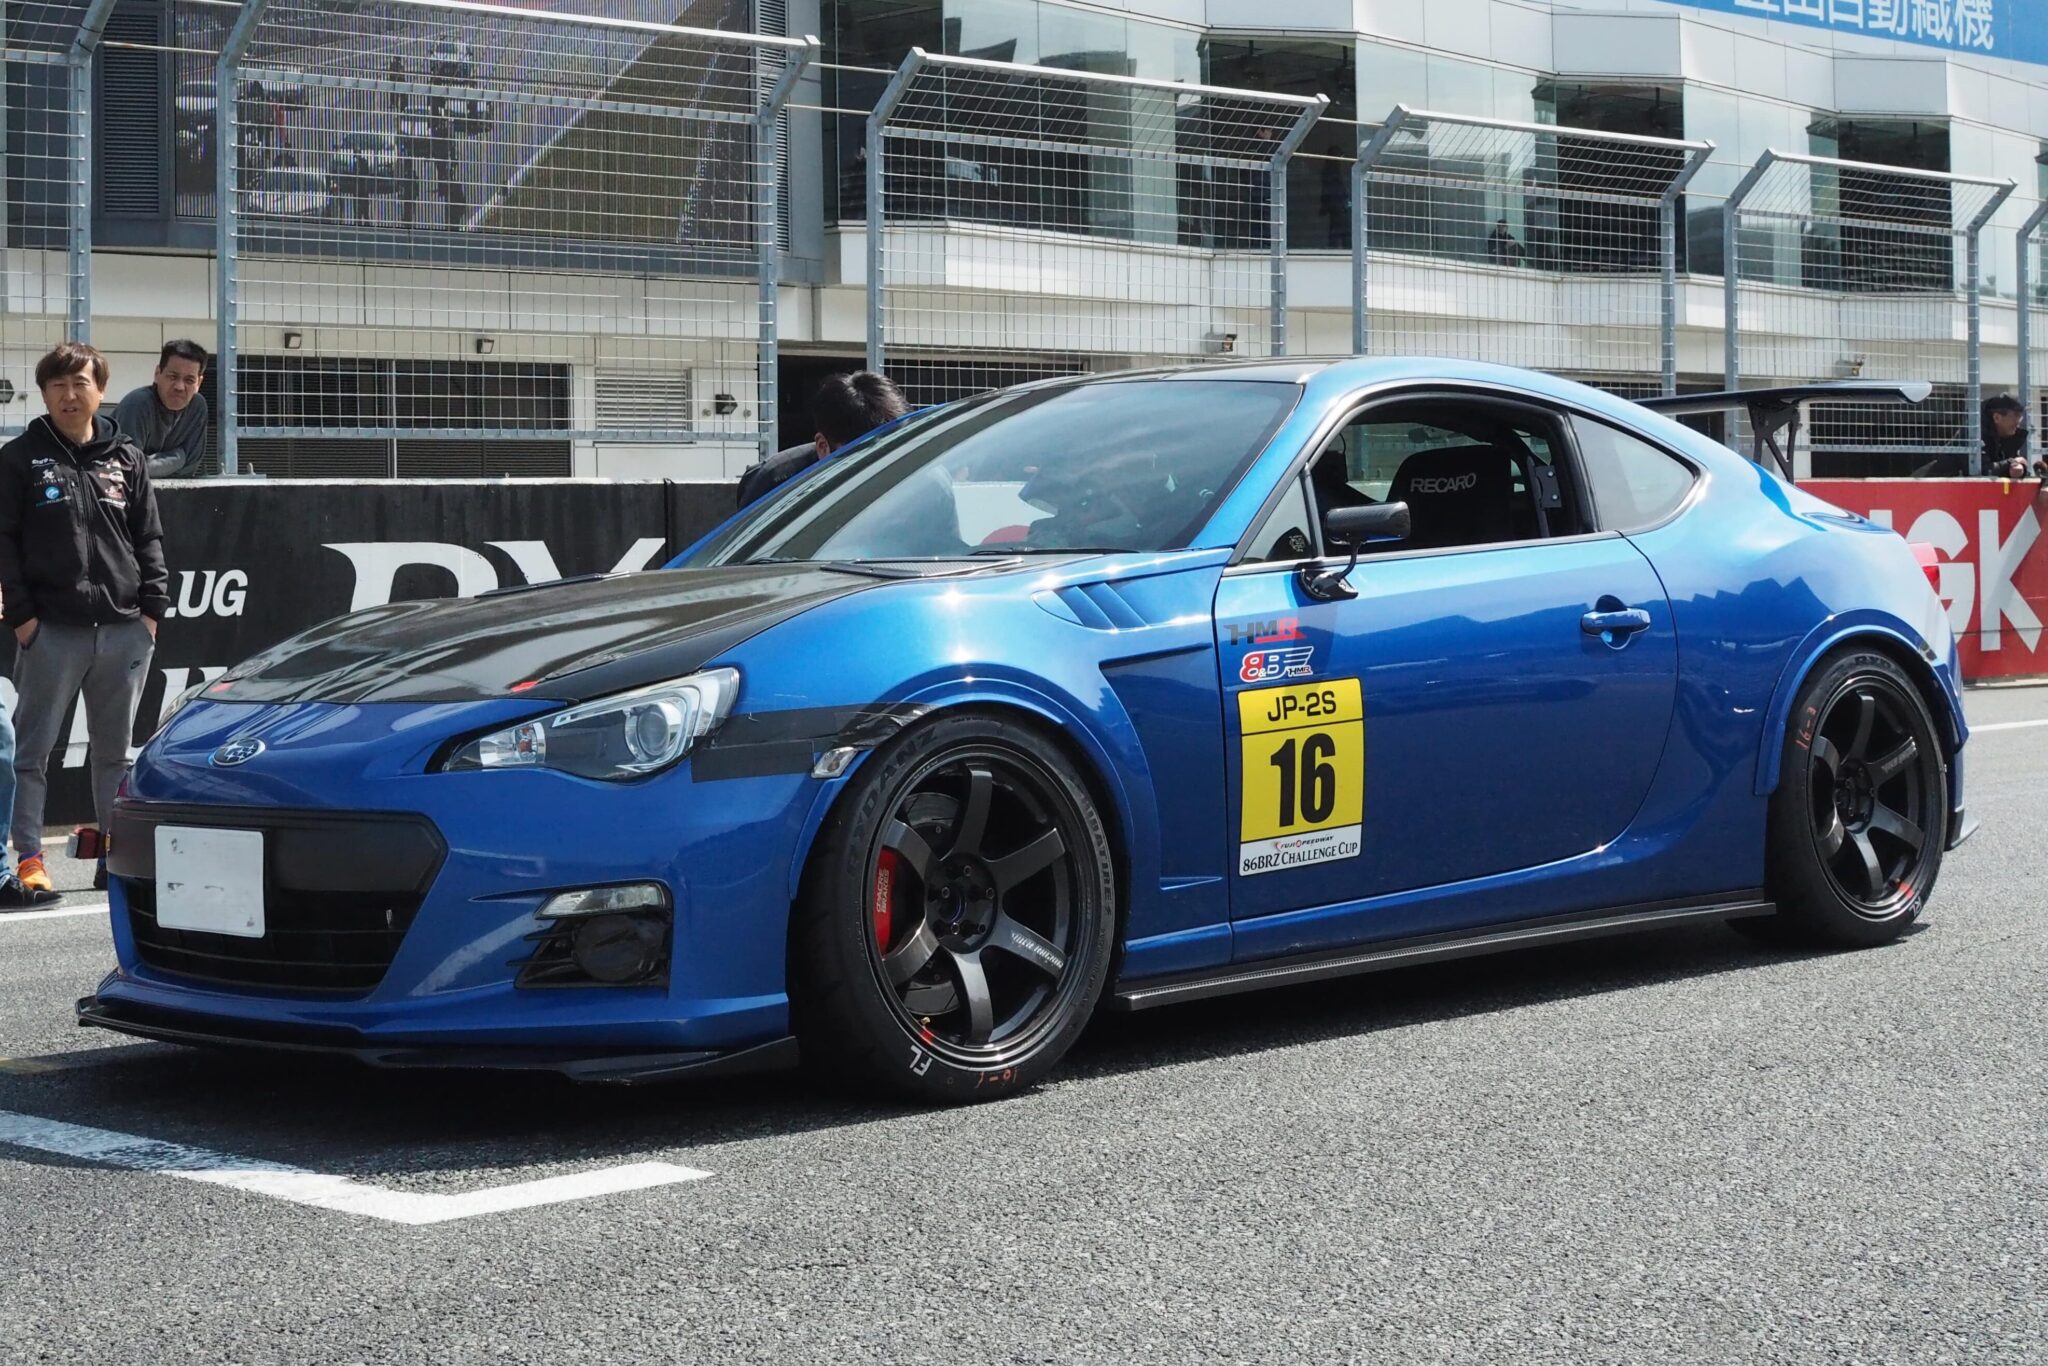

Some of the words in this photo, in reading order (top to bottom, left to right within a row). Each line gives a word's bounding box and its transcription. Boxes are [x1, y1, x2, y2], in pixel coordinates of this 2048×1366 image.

[1734, 0, 1994, 50] 動織機
[1410, 472, 1477, 494] RECARO
[1868, 505, 2043, 654] GK
[1223, 617, 1304, 646] HMR
[1267, 690, 1337, 722] JP-2S
[1270, 732, 1336, 828] 16
[1243, 850, 1281, 873] 86BRZ
[1281, 844, 1337, 866] CHALLENGE
[1338, 841, 1358, 855] CUP
[909, 1045, 933, 1077] FL
